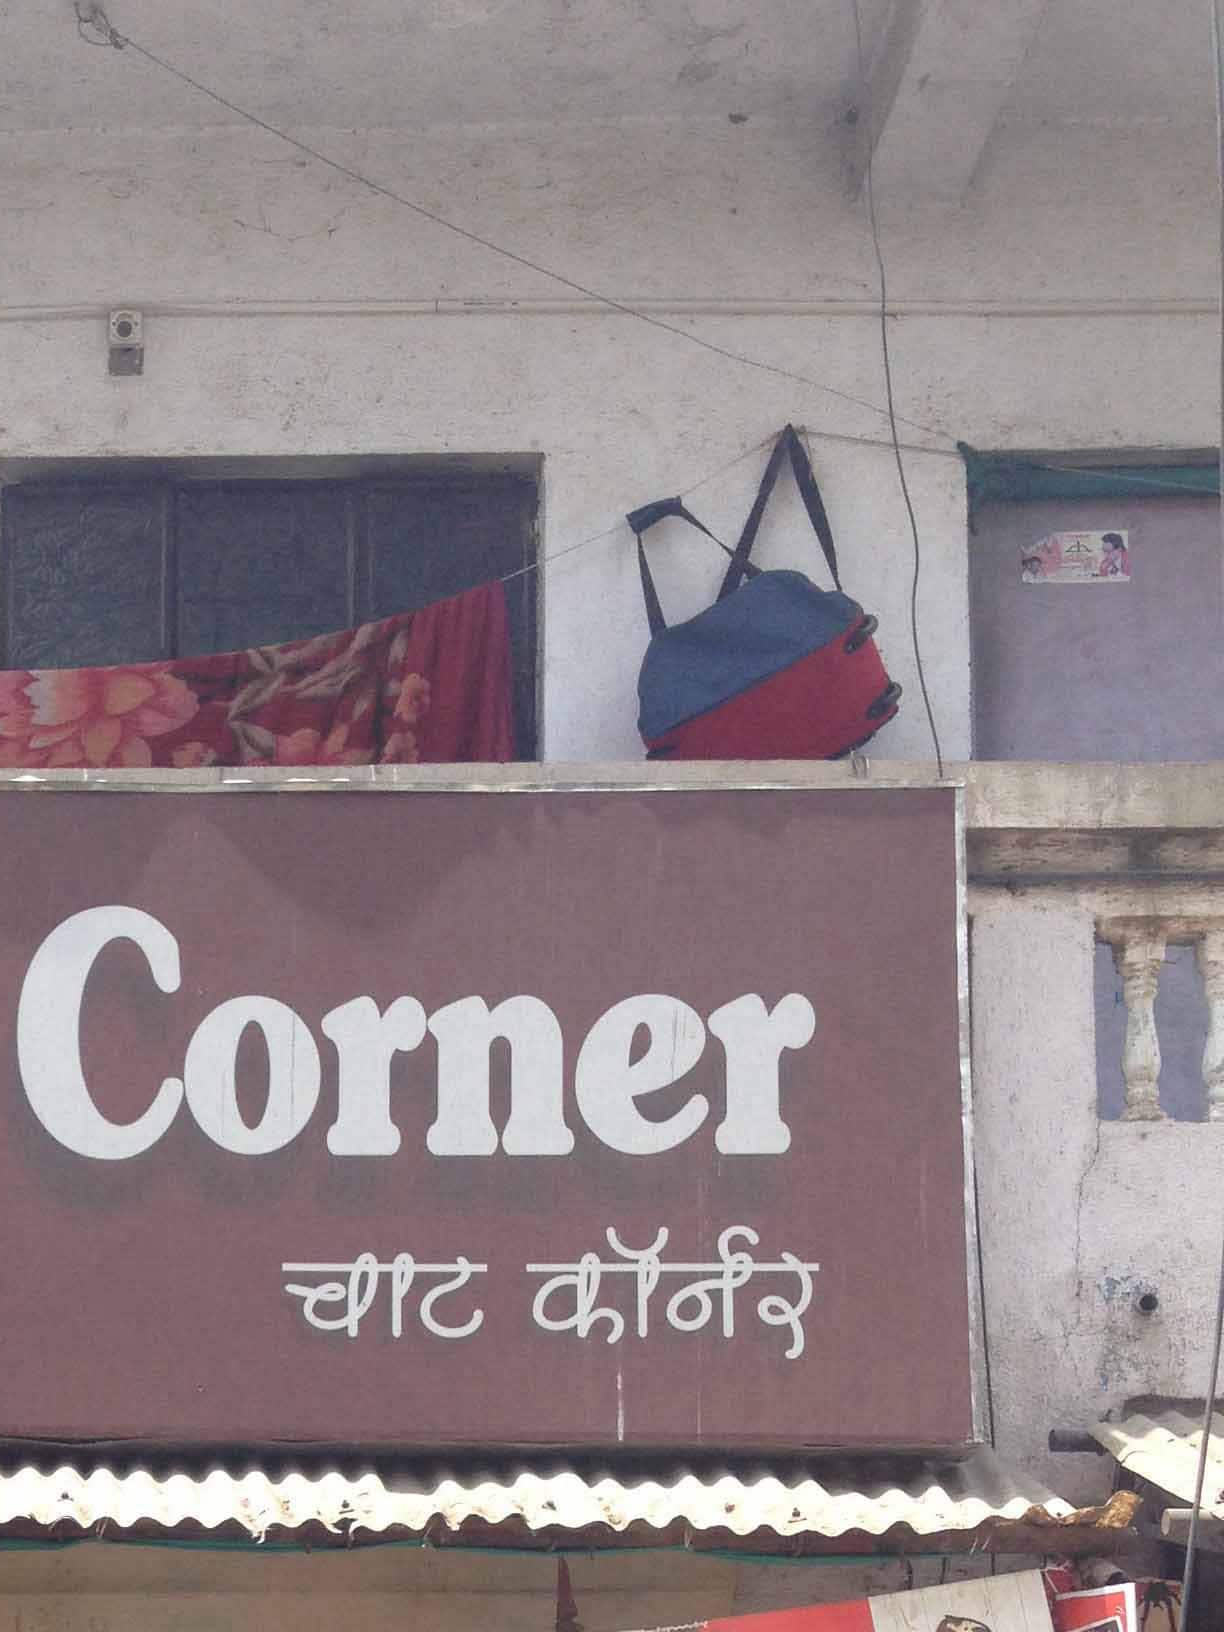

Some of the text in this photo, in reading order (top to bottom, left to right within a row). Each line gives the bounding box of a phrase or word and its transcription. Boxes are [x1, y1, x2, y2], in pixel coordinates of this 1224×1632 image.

[14, 902, 817, 1161] Corner
[282, 1225, 820, 1360] चाट कॉर्नर
